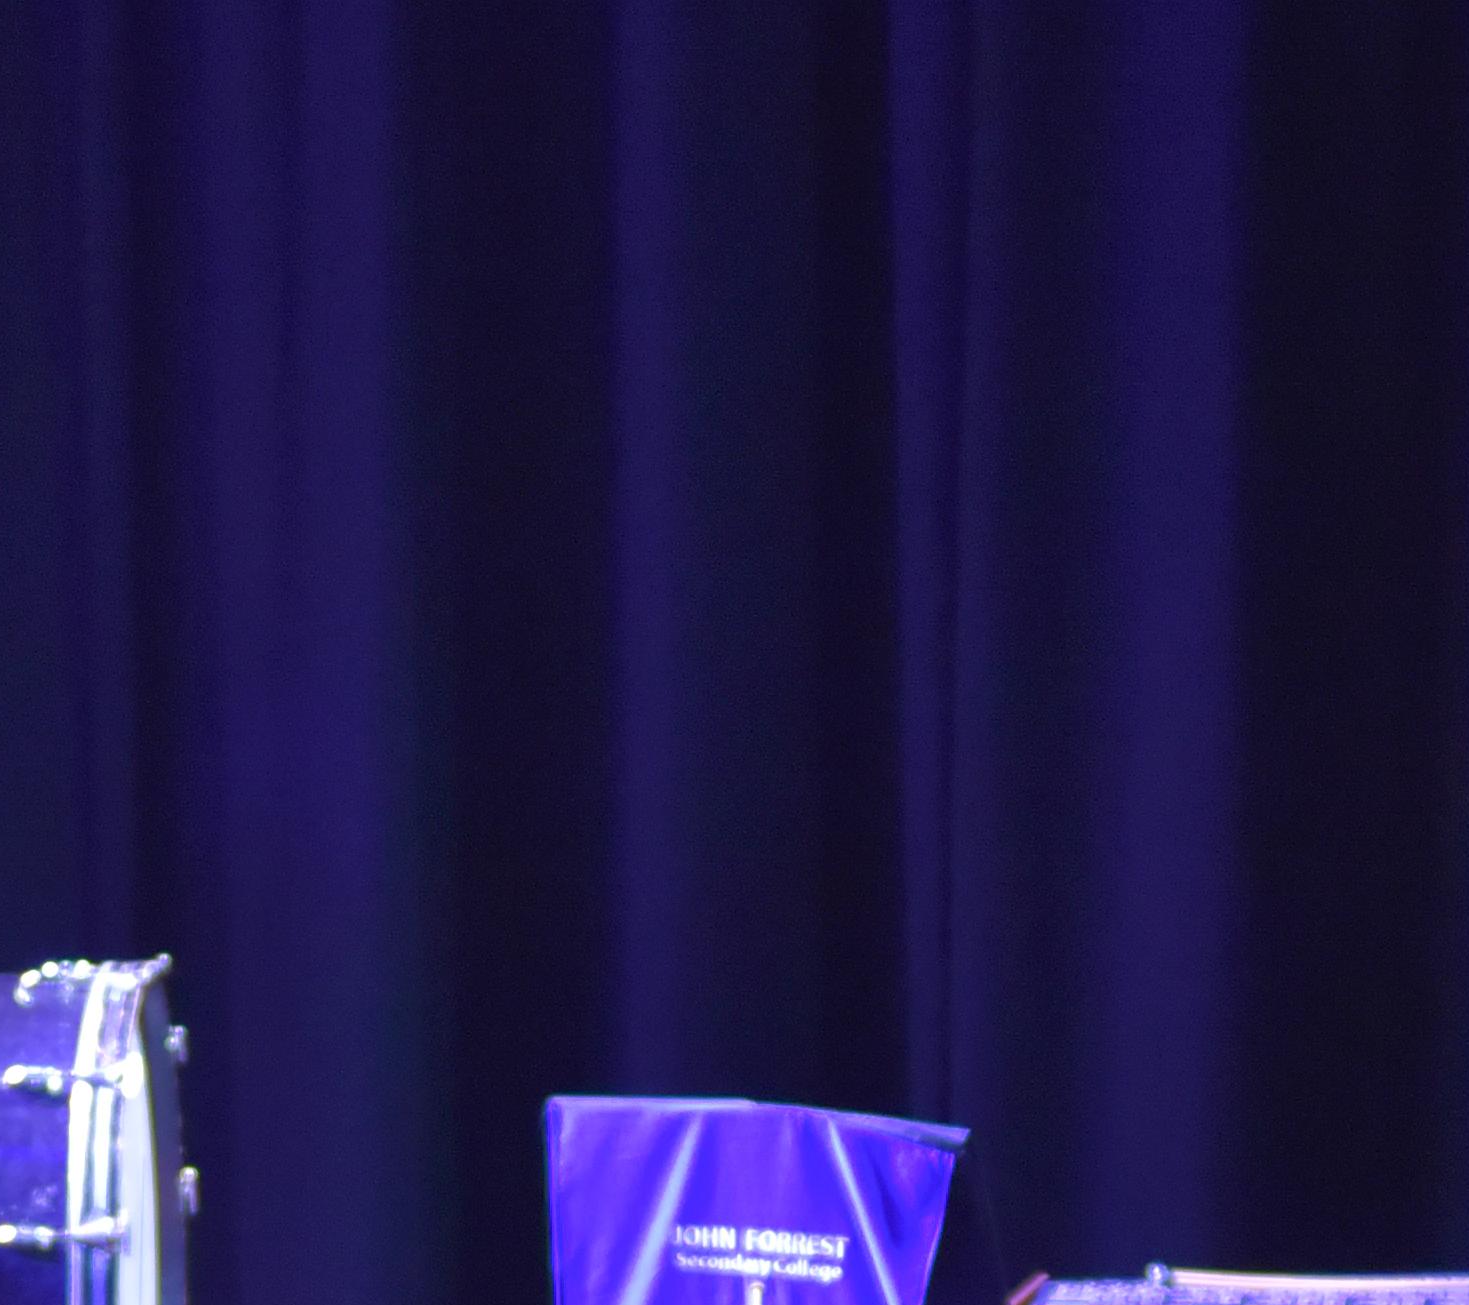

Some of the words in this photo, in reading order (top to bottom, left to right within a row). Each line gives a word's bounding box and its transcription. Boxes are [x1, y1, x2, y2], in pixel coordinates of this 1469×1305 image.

[676, 1226, 736, 1250] JOHN
[744, 1228, 850, 1260] FORREST
[676, 1252, 770, 1276] Secondary
[772, 1258, 843, 1284] College
